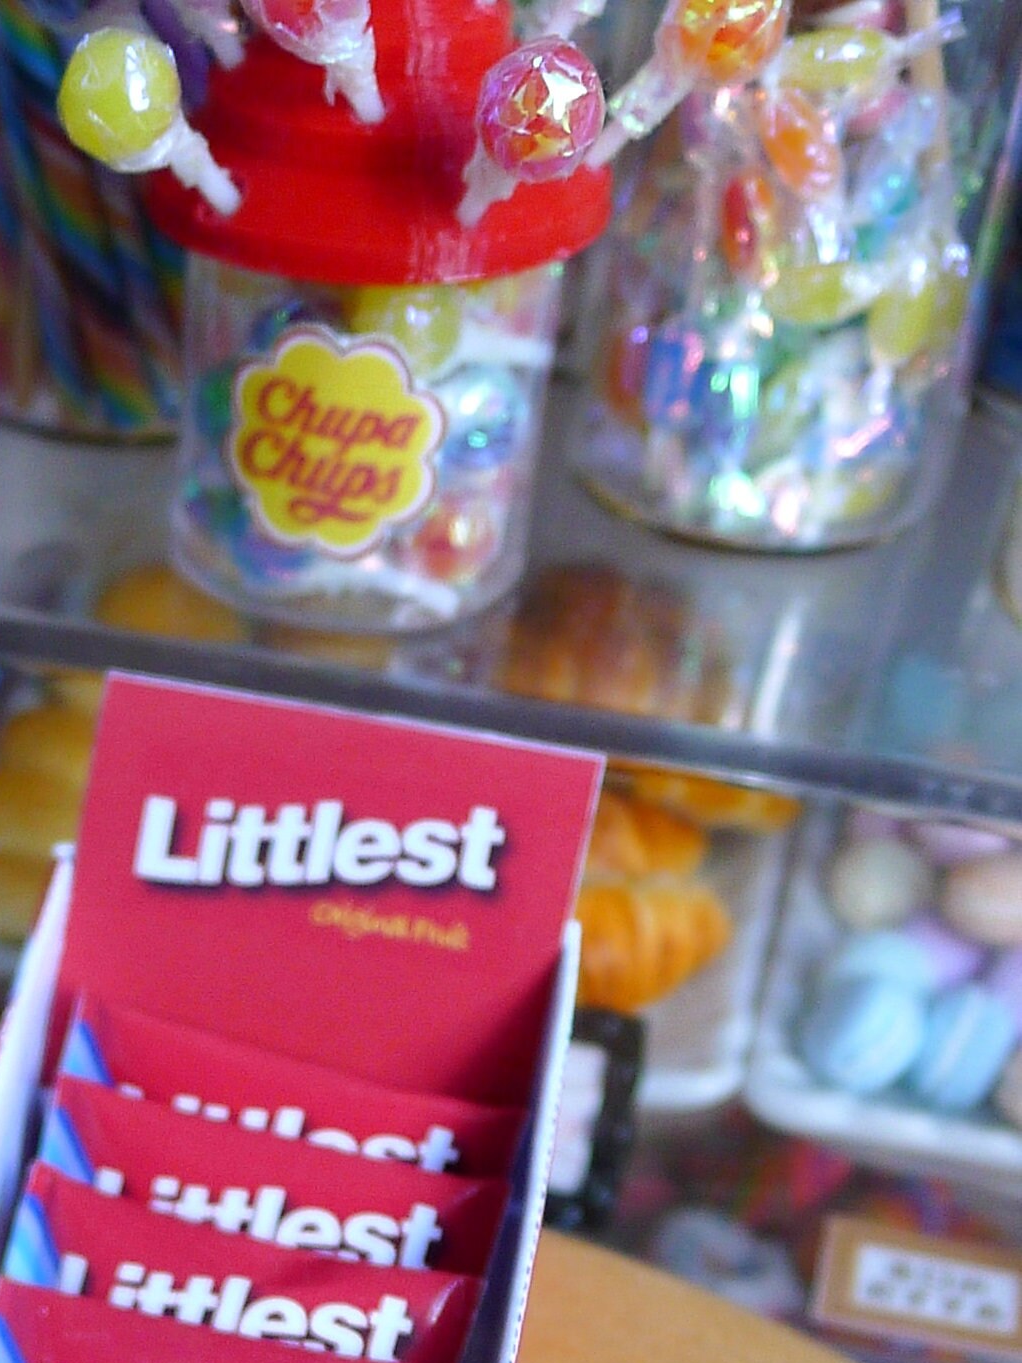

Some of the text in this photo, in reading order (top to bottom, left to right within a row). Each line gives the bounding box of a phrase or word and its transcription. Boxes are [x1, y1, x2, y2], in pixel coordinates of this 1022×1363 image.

[257, 377, 420, 458] Chupa
[241, 428, 402, 523] Chups
[133, 794, 506, 890] Littlest
